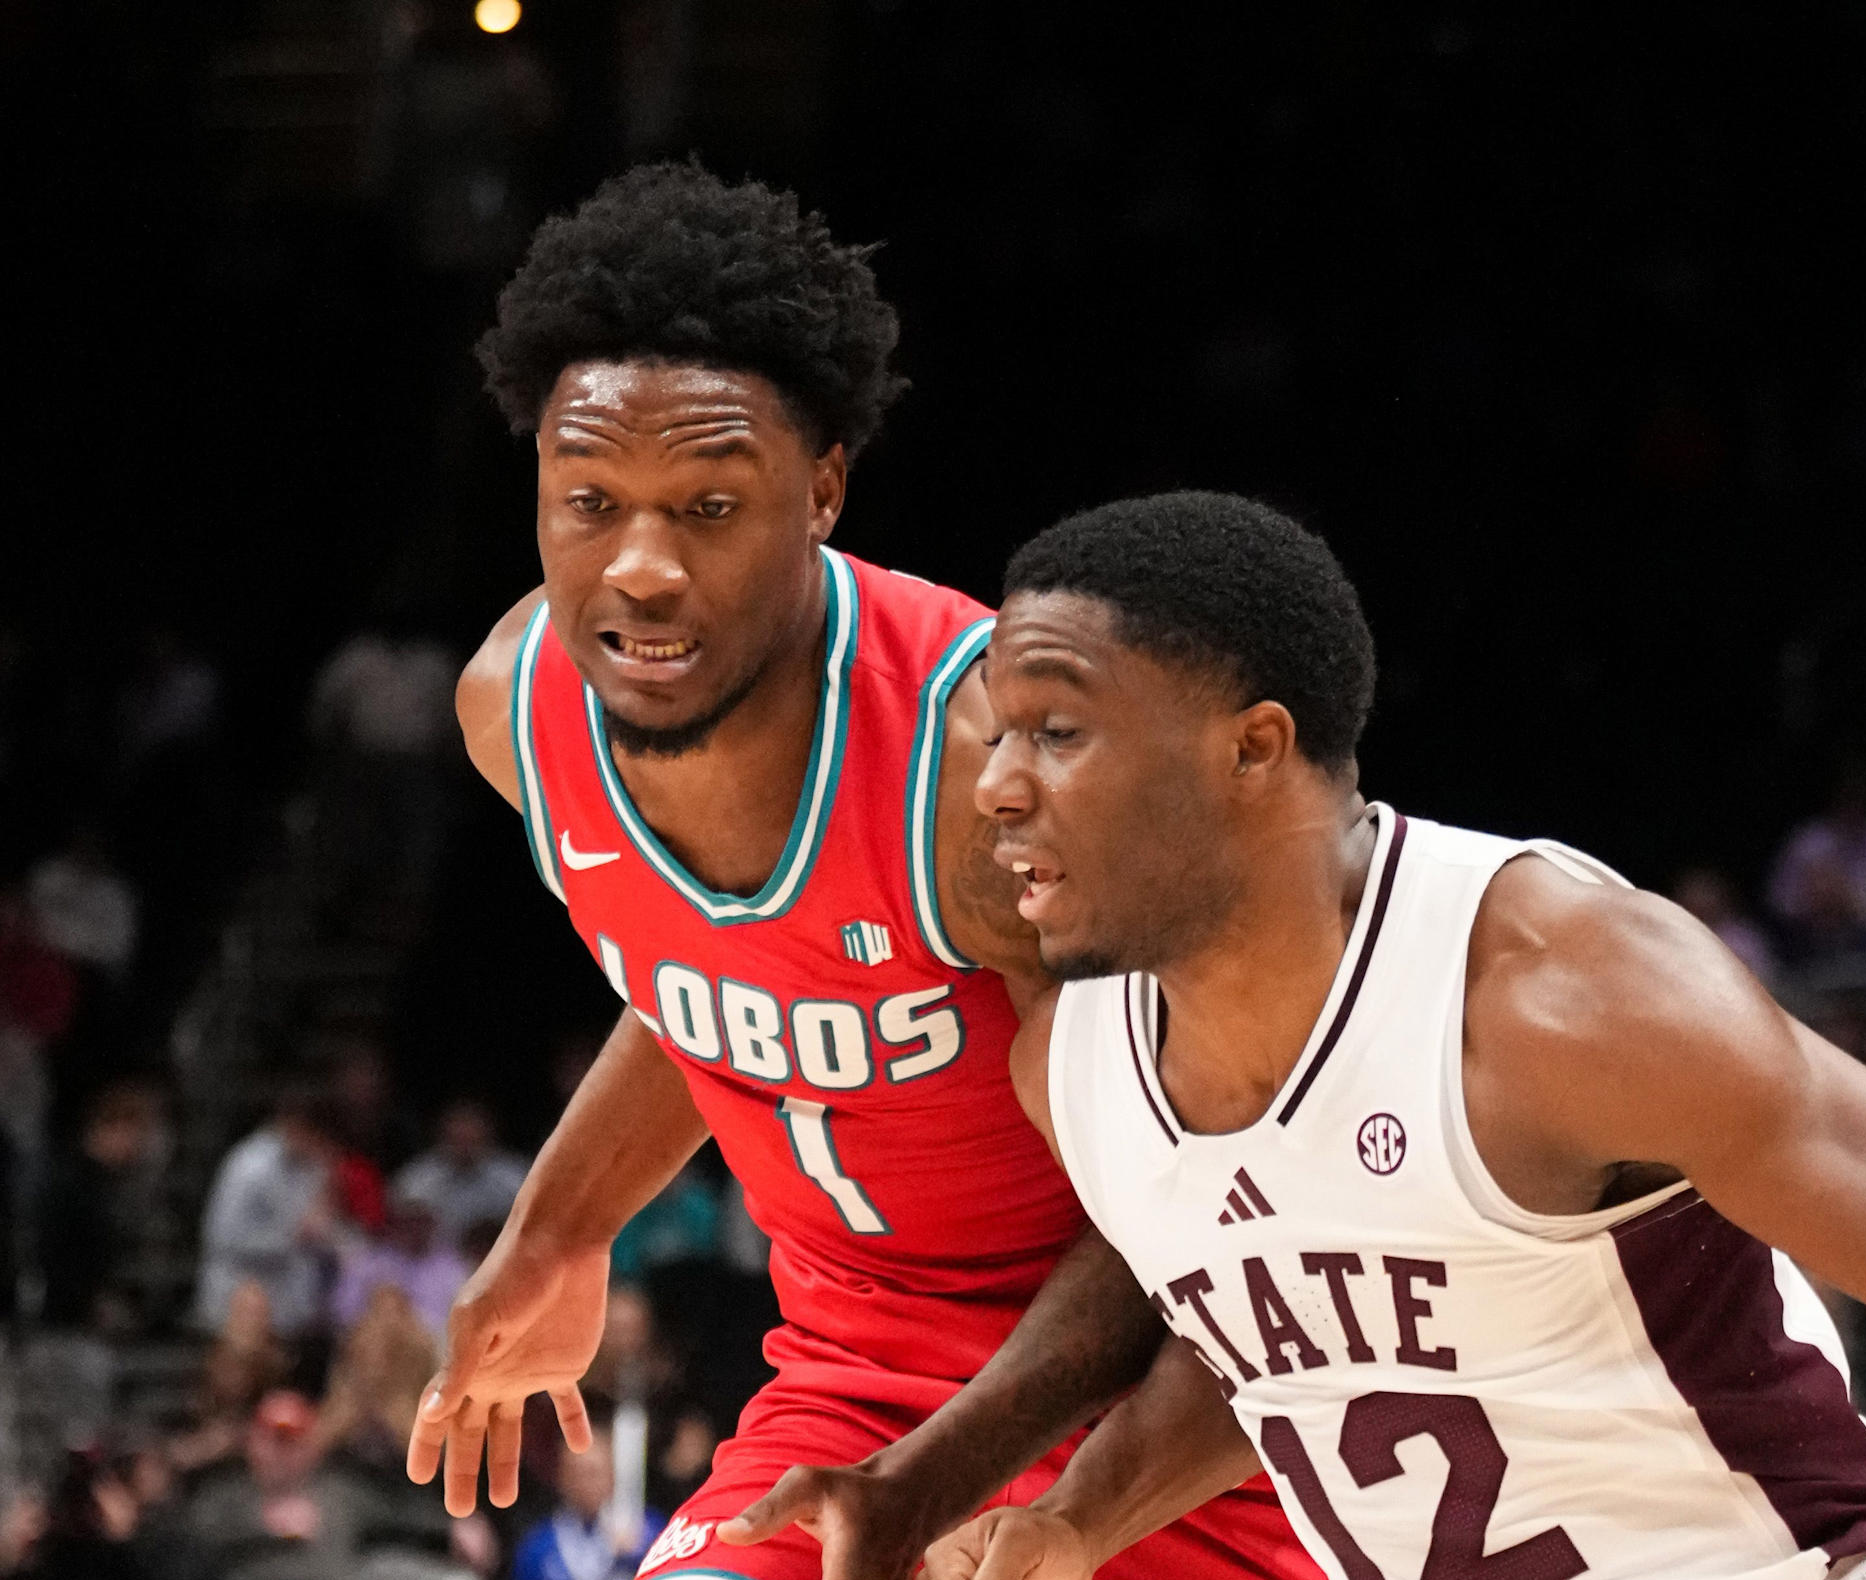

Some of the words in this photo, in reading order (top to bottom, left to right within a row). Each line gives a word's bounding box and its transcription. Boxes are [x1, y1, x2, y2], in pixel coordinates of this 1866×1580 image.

[597, 933, 967, 1091] LOBOS
[775, 1095, 893, 1236] 1
[1359, 1117, 1403, 1174] SEC
